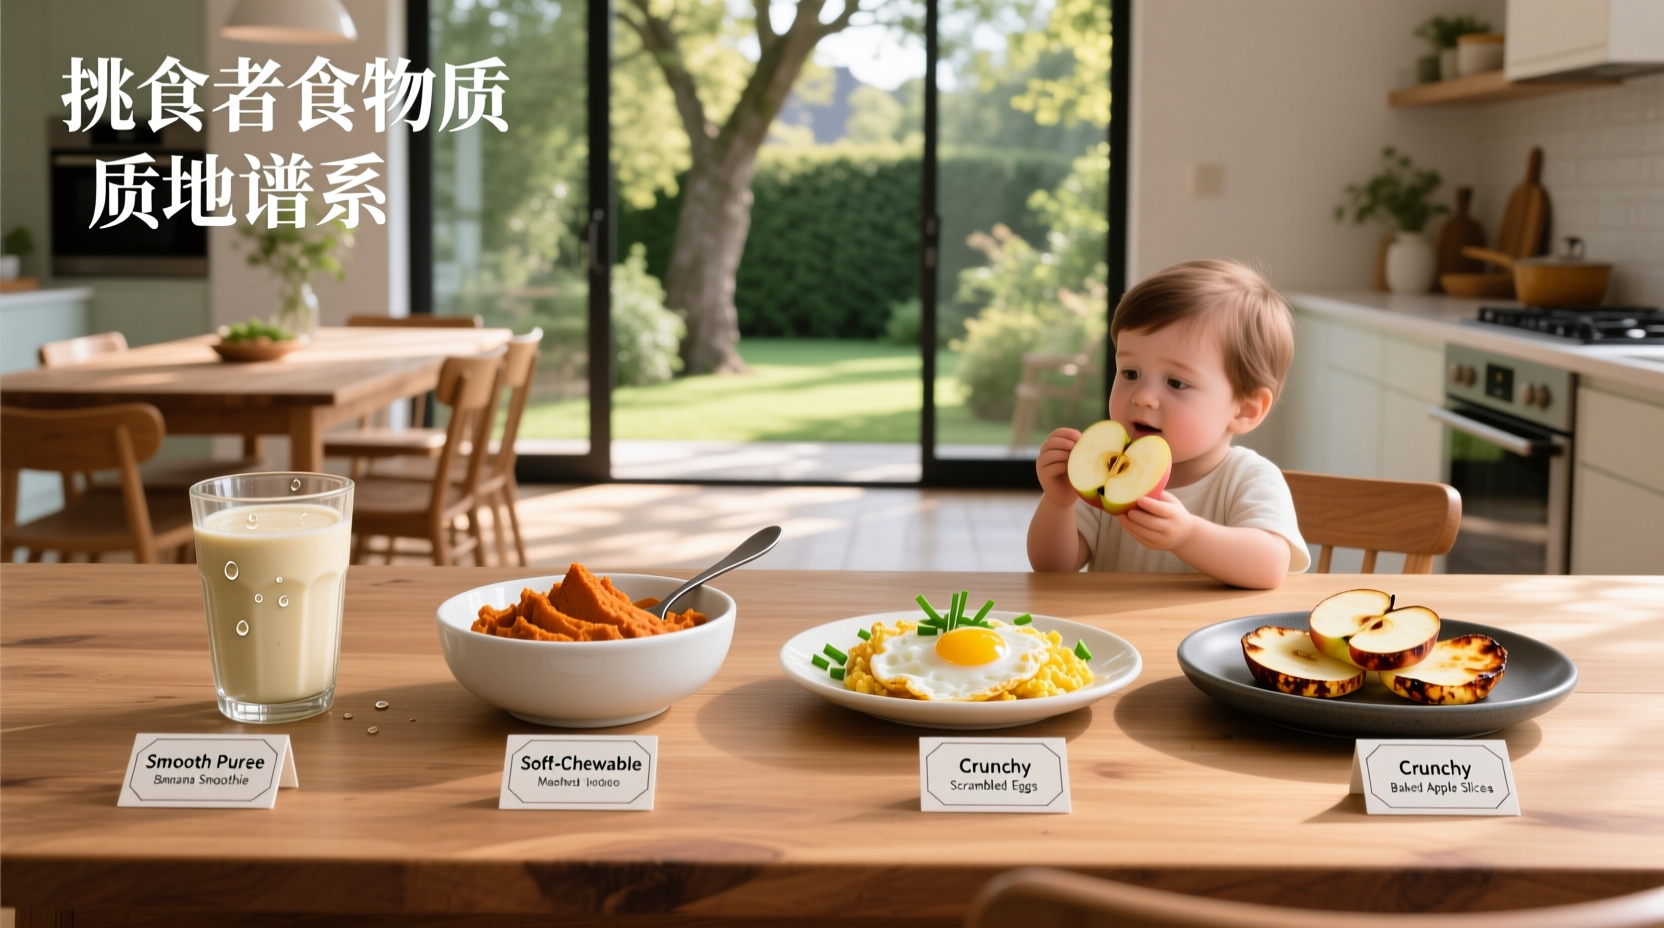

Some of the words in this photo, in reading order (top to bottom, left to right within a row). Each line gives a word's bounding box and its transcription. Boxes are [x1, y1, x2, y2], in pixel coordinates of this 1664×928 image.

[145, 753, 212, 769] Smooth
[216, 754, 265, 770] Puree
[959, 757, 1031, 779] Crunchy
[1399, 759, 1471, 780] Crunchy
[199, 774, 249, 786] Smoothie
[950, 779, 1008, 791] Scrambled
[1012, 780, 1038, 794] Eggs
